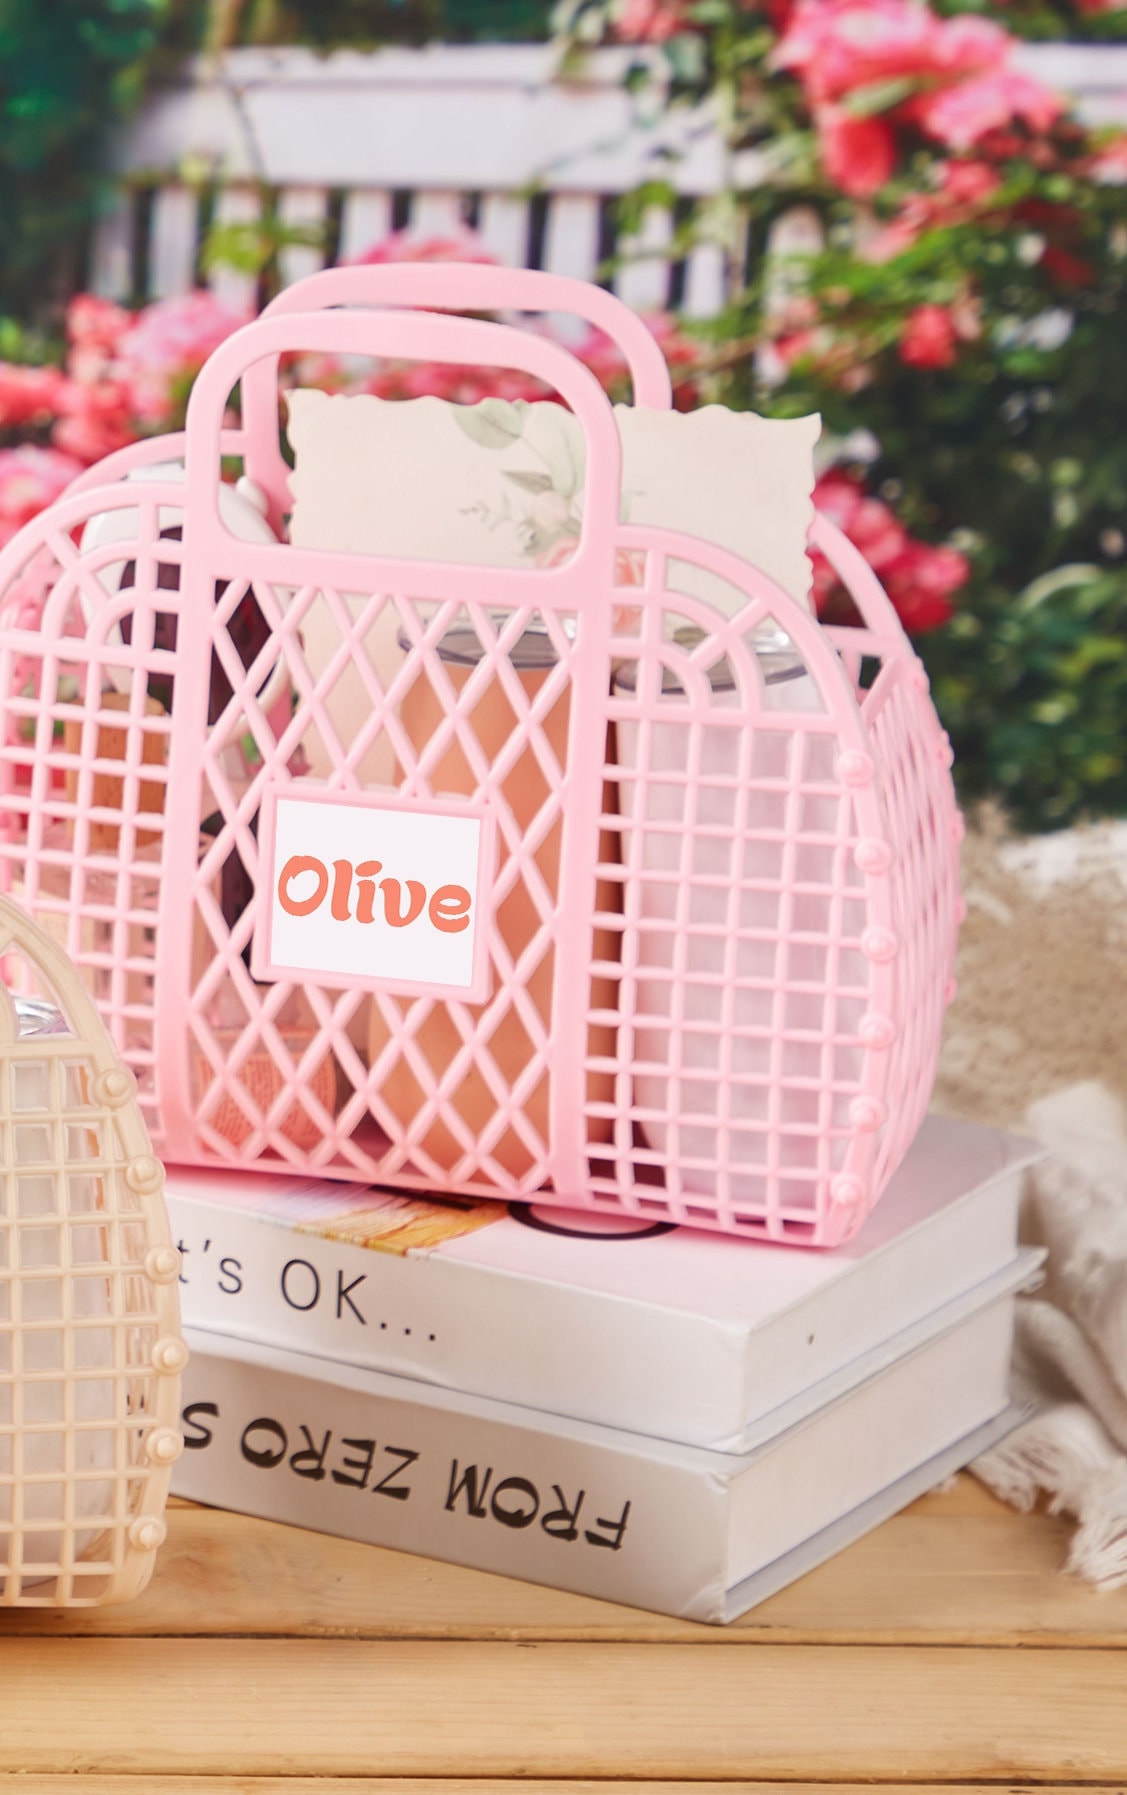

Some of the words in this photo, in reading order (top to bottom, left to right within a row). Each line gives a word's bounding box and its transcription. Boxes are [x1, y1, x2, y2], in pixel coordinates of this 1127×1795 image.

[277, 855, 472, 934] Olive
[240, 1417, 421, 1501] ZERO
[444, 1458, 632, 1550] FROM
